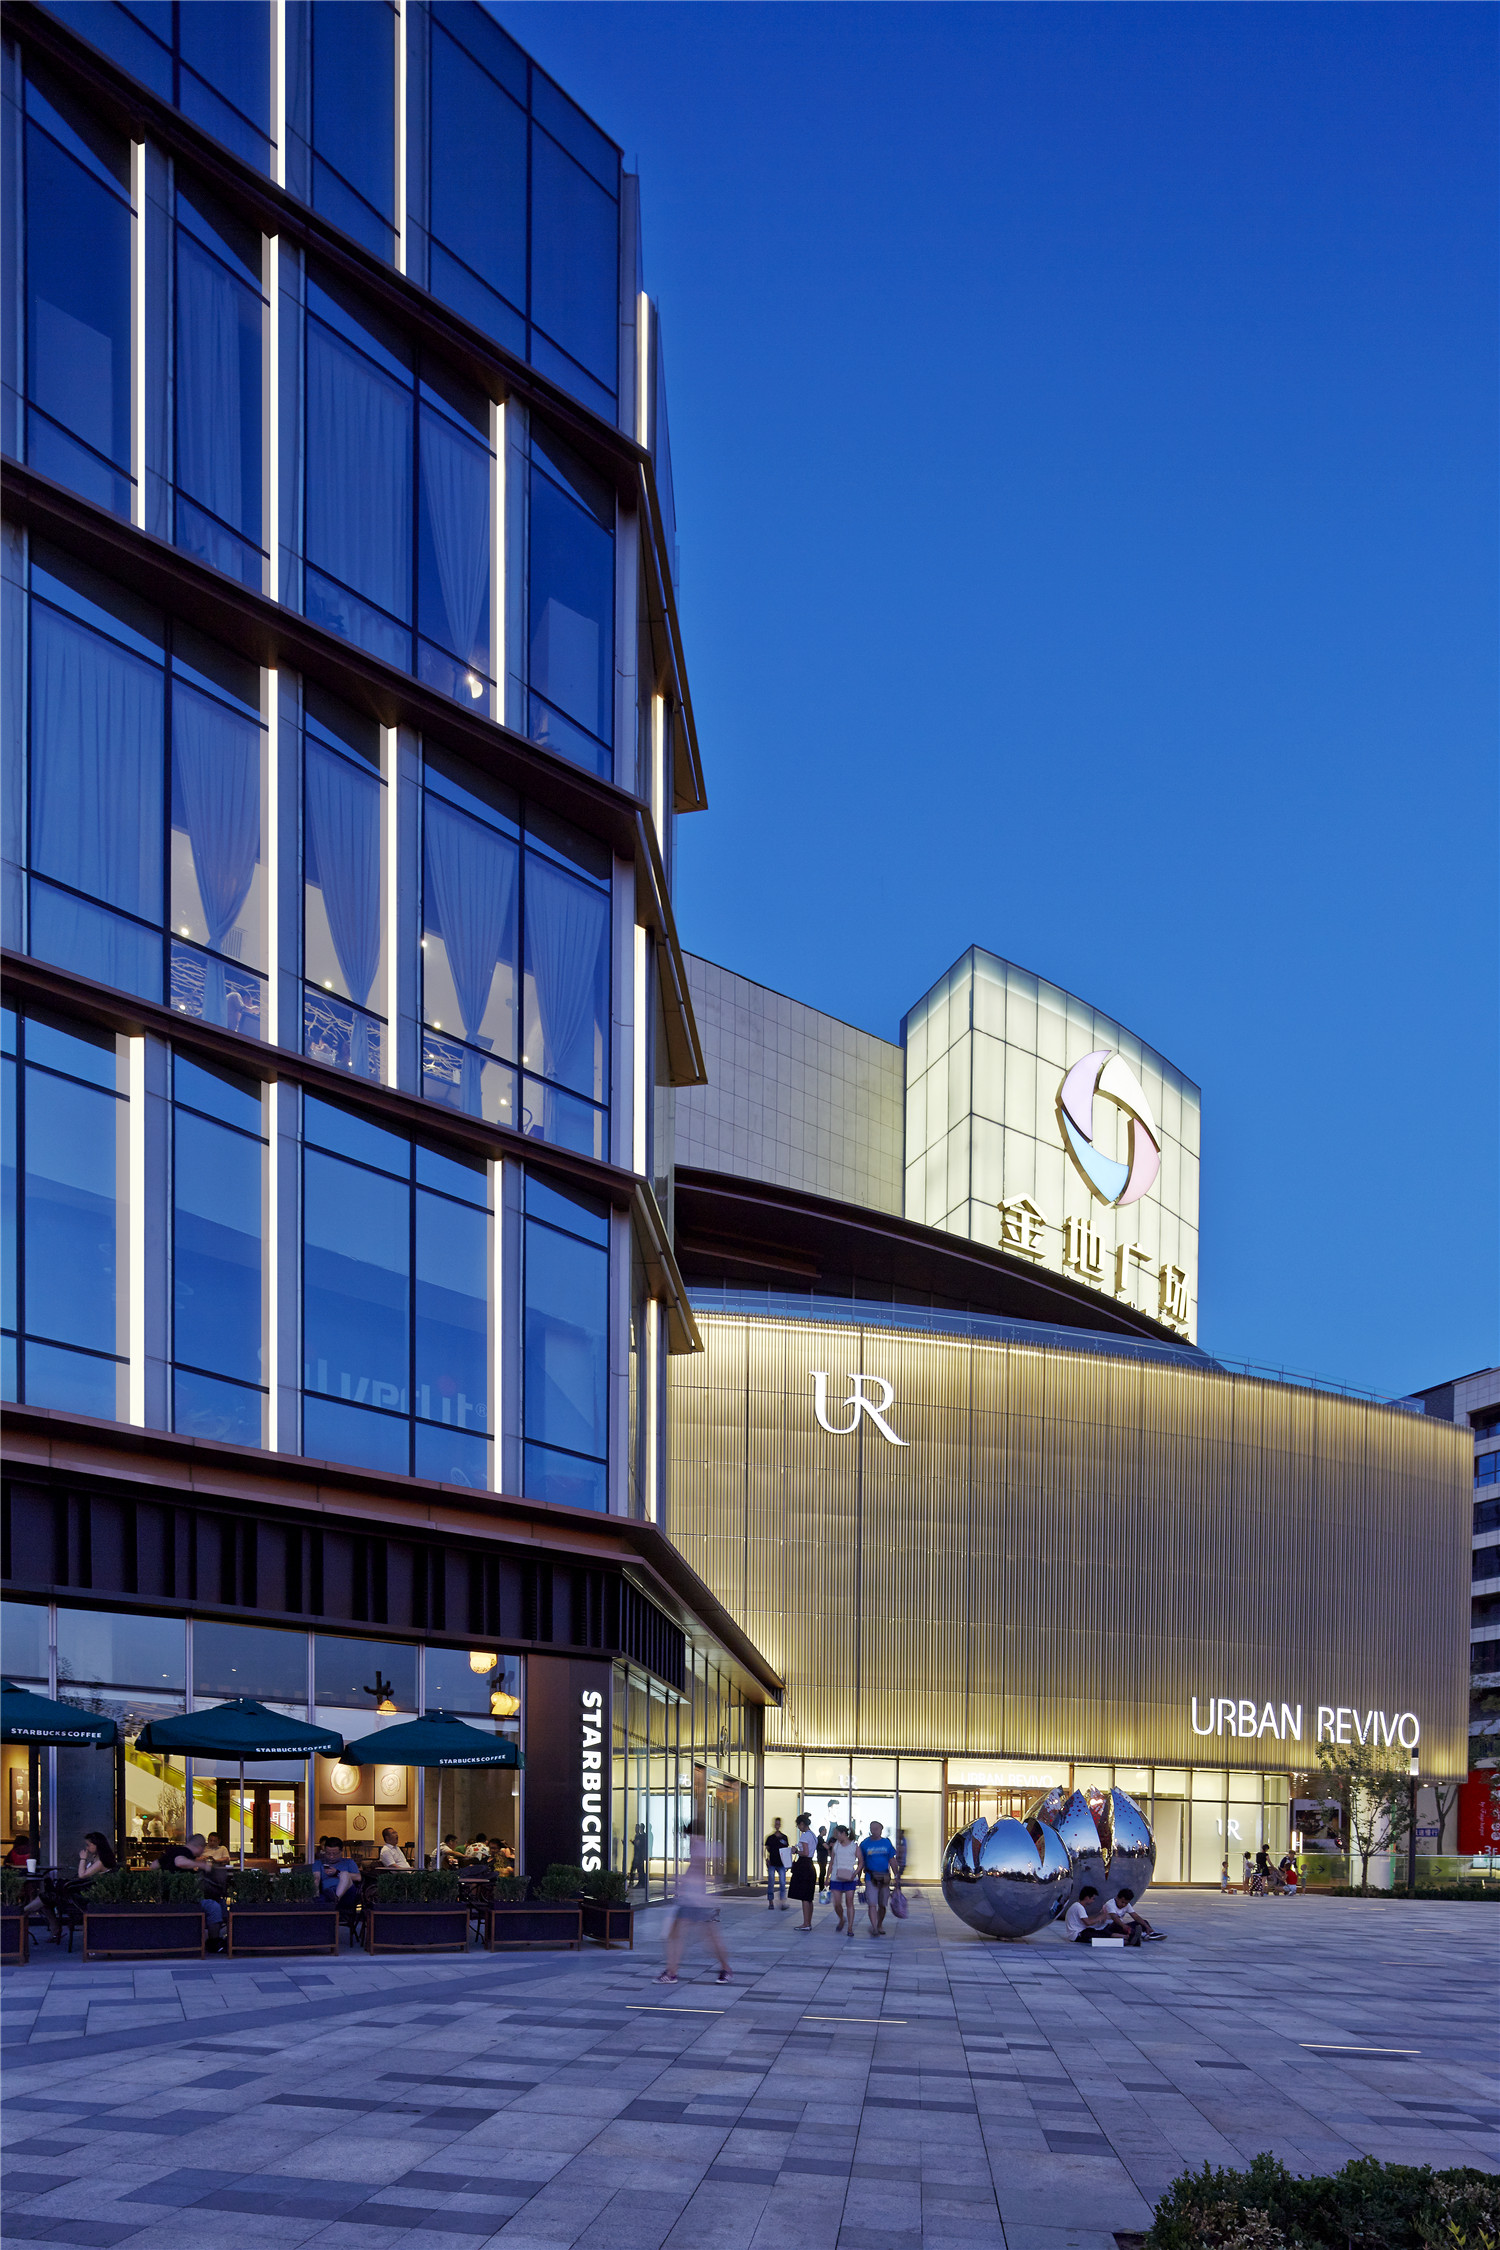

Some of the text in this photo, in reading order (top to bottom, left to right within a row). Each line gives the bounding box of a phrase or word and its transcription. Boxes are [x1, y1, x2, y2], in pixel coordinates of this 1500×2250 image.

[998, 1192, 1192, 1325] 金地广场
[808, 1370, 910, 1446] UR
[10, 1728, 103, 1739] STARBUCKS COFFEE
[1191, 1697, 1420, 1749] URBAN REVIVO
[481, 1754, 506, 1762] COFFEE
[581, 1690, 602, 1873] STARBUCKS
[960, 1772, 1054, 1789] URBAN REVIVO
